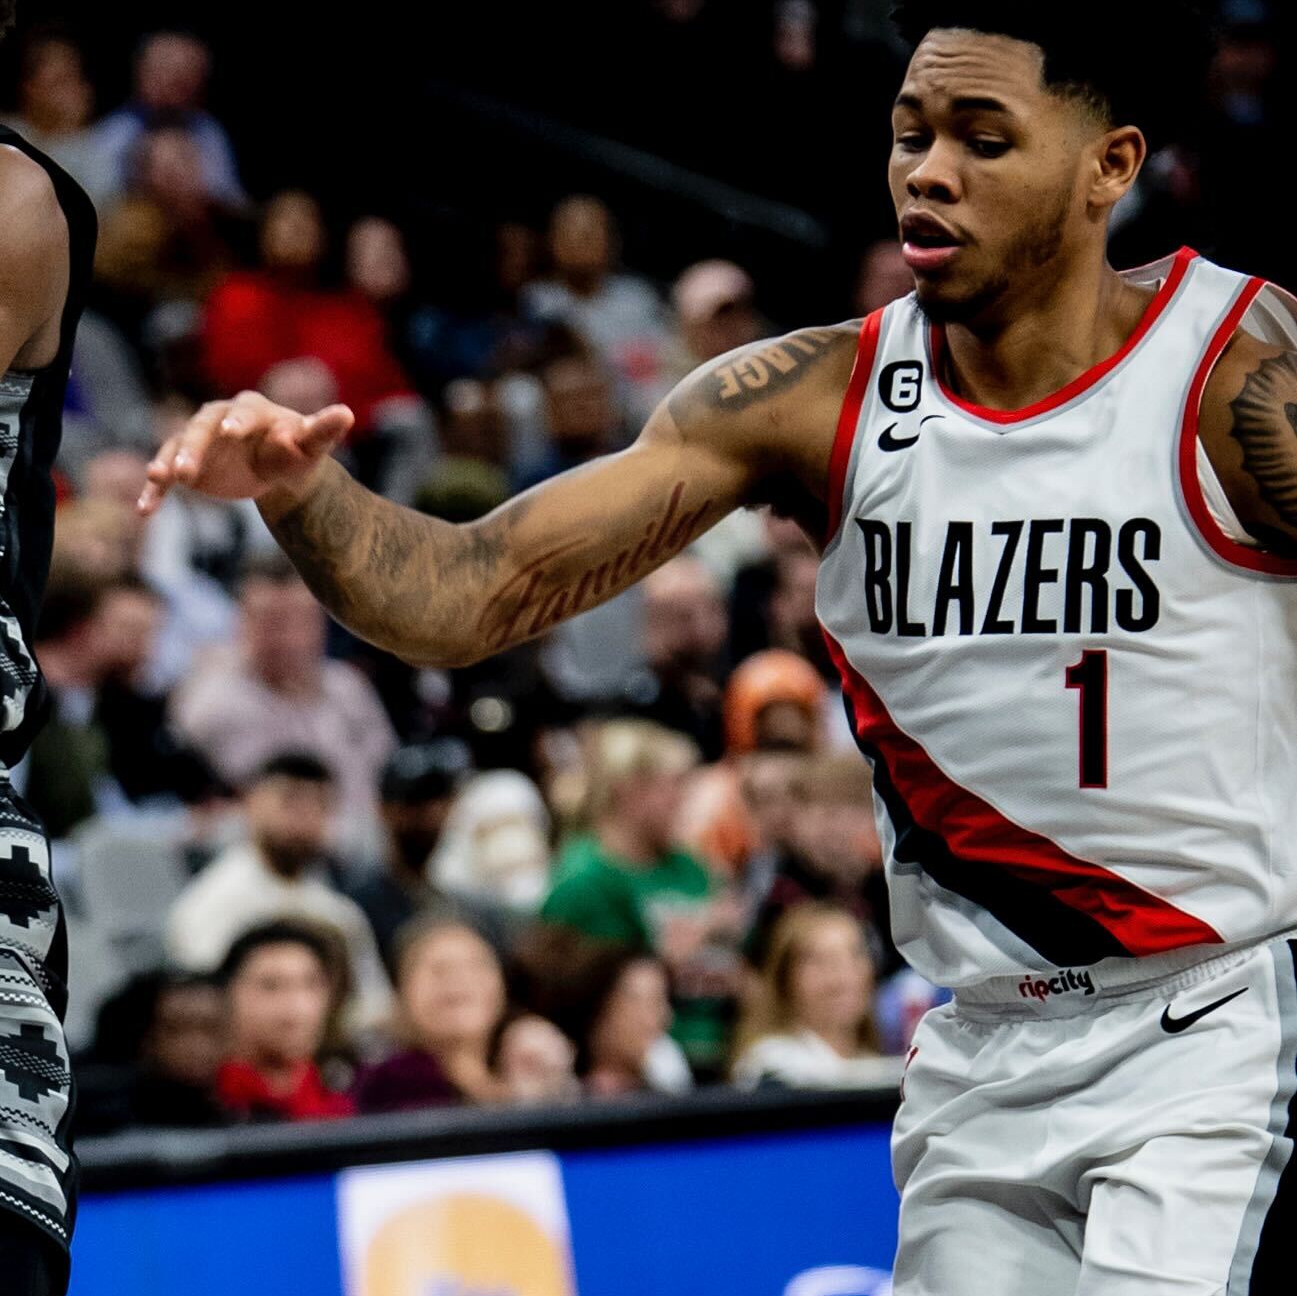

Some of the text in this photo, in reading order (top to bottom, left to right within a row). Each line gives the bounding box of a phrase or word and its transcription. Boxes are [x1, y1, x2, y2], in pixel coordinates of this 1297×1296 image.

[889, 366, 921, 407] 6
[855, 517, 1161, 637] BLAZERS
[1065, 649, 1107, 789] 1
[1019, 968, 1096, 1003] ripcity
